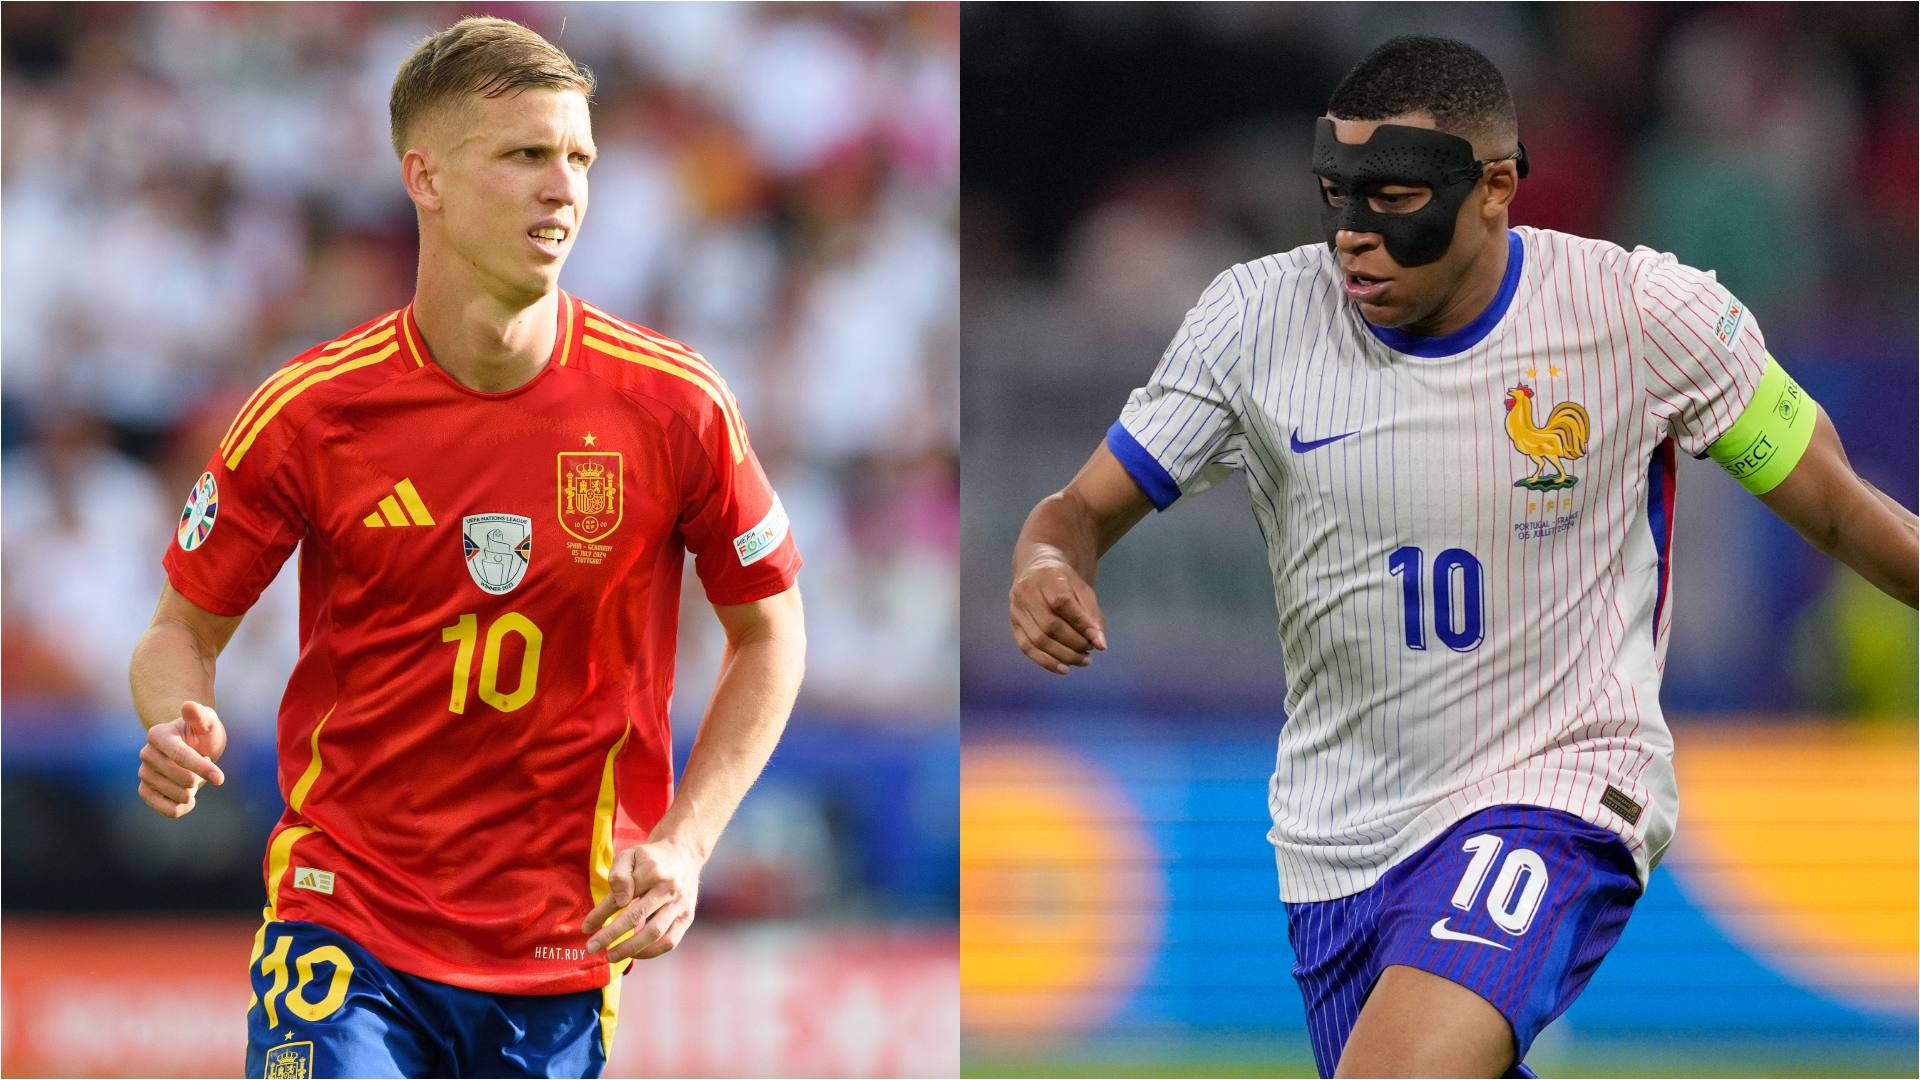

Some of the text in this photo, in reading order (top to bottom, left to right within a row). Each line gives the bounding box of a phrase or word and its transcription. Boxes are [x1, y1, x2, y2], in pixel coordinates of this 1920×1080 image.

[1721, 435, 1772, 475] SPECT
[466, 516, 481, 524] UEFA
[506, 516, 528, 524] LEAGUE
[1514, 520, 1549, 531] PORTUGAL
[737, 531, 756, 546] UEFA
[566, 541, 582, 549] SPAIN
[587, 544, 613, 552] GERMANY
[574, 557, 603, 565] STUTTGART
[592, 551, 607, 559] 2024
[480, 581, 514, 592] WINNER 2023
[1388, 545, 1485, 653] 10
[441, 611, 544, 715] 10
[1451, 833, 1549, 936] 10
[534, 946, 586, 961] HEAT.RDY
[261, 935, 355, 1030] 10
